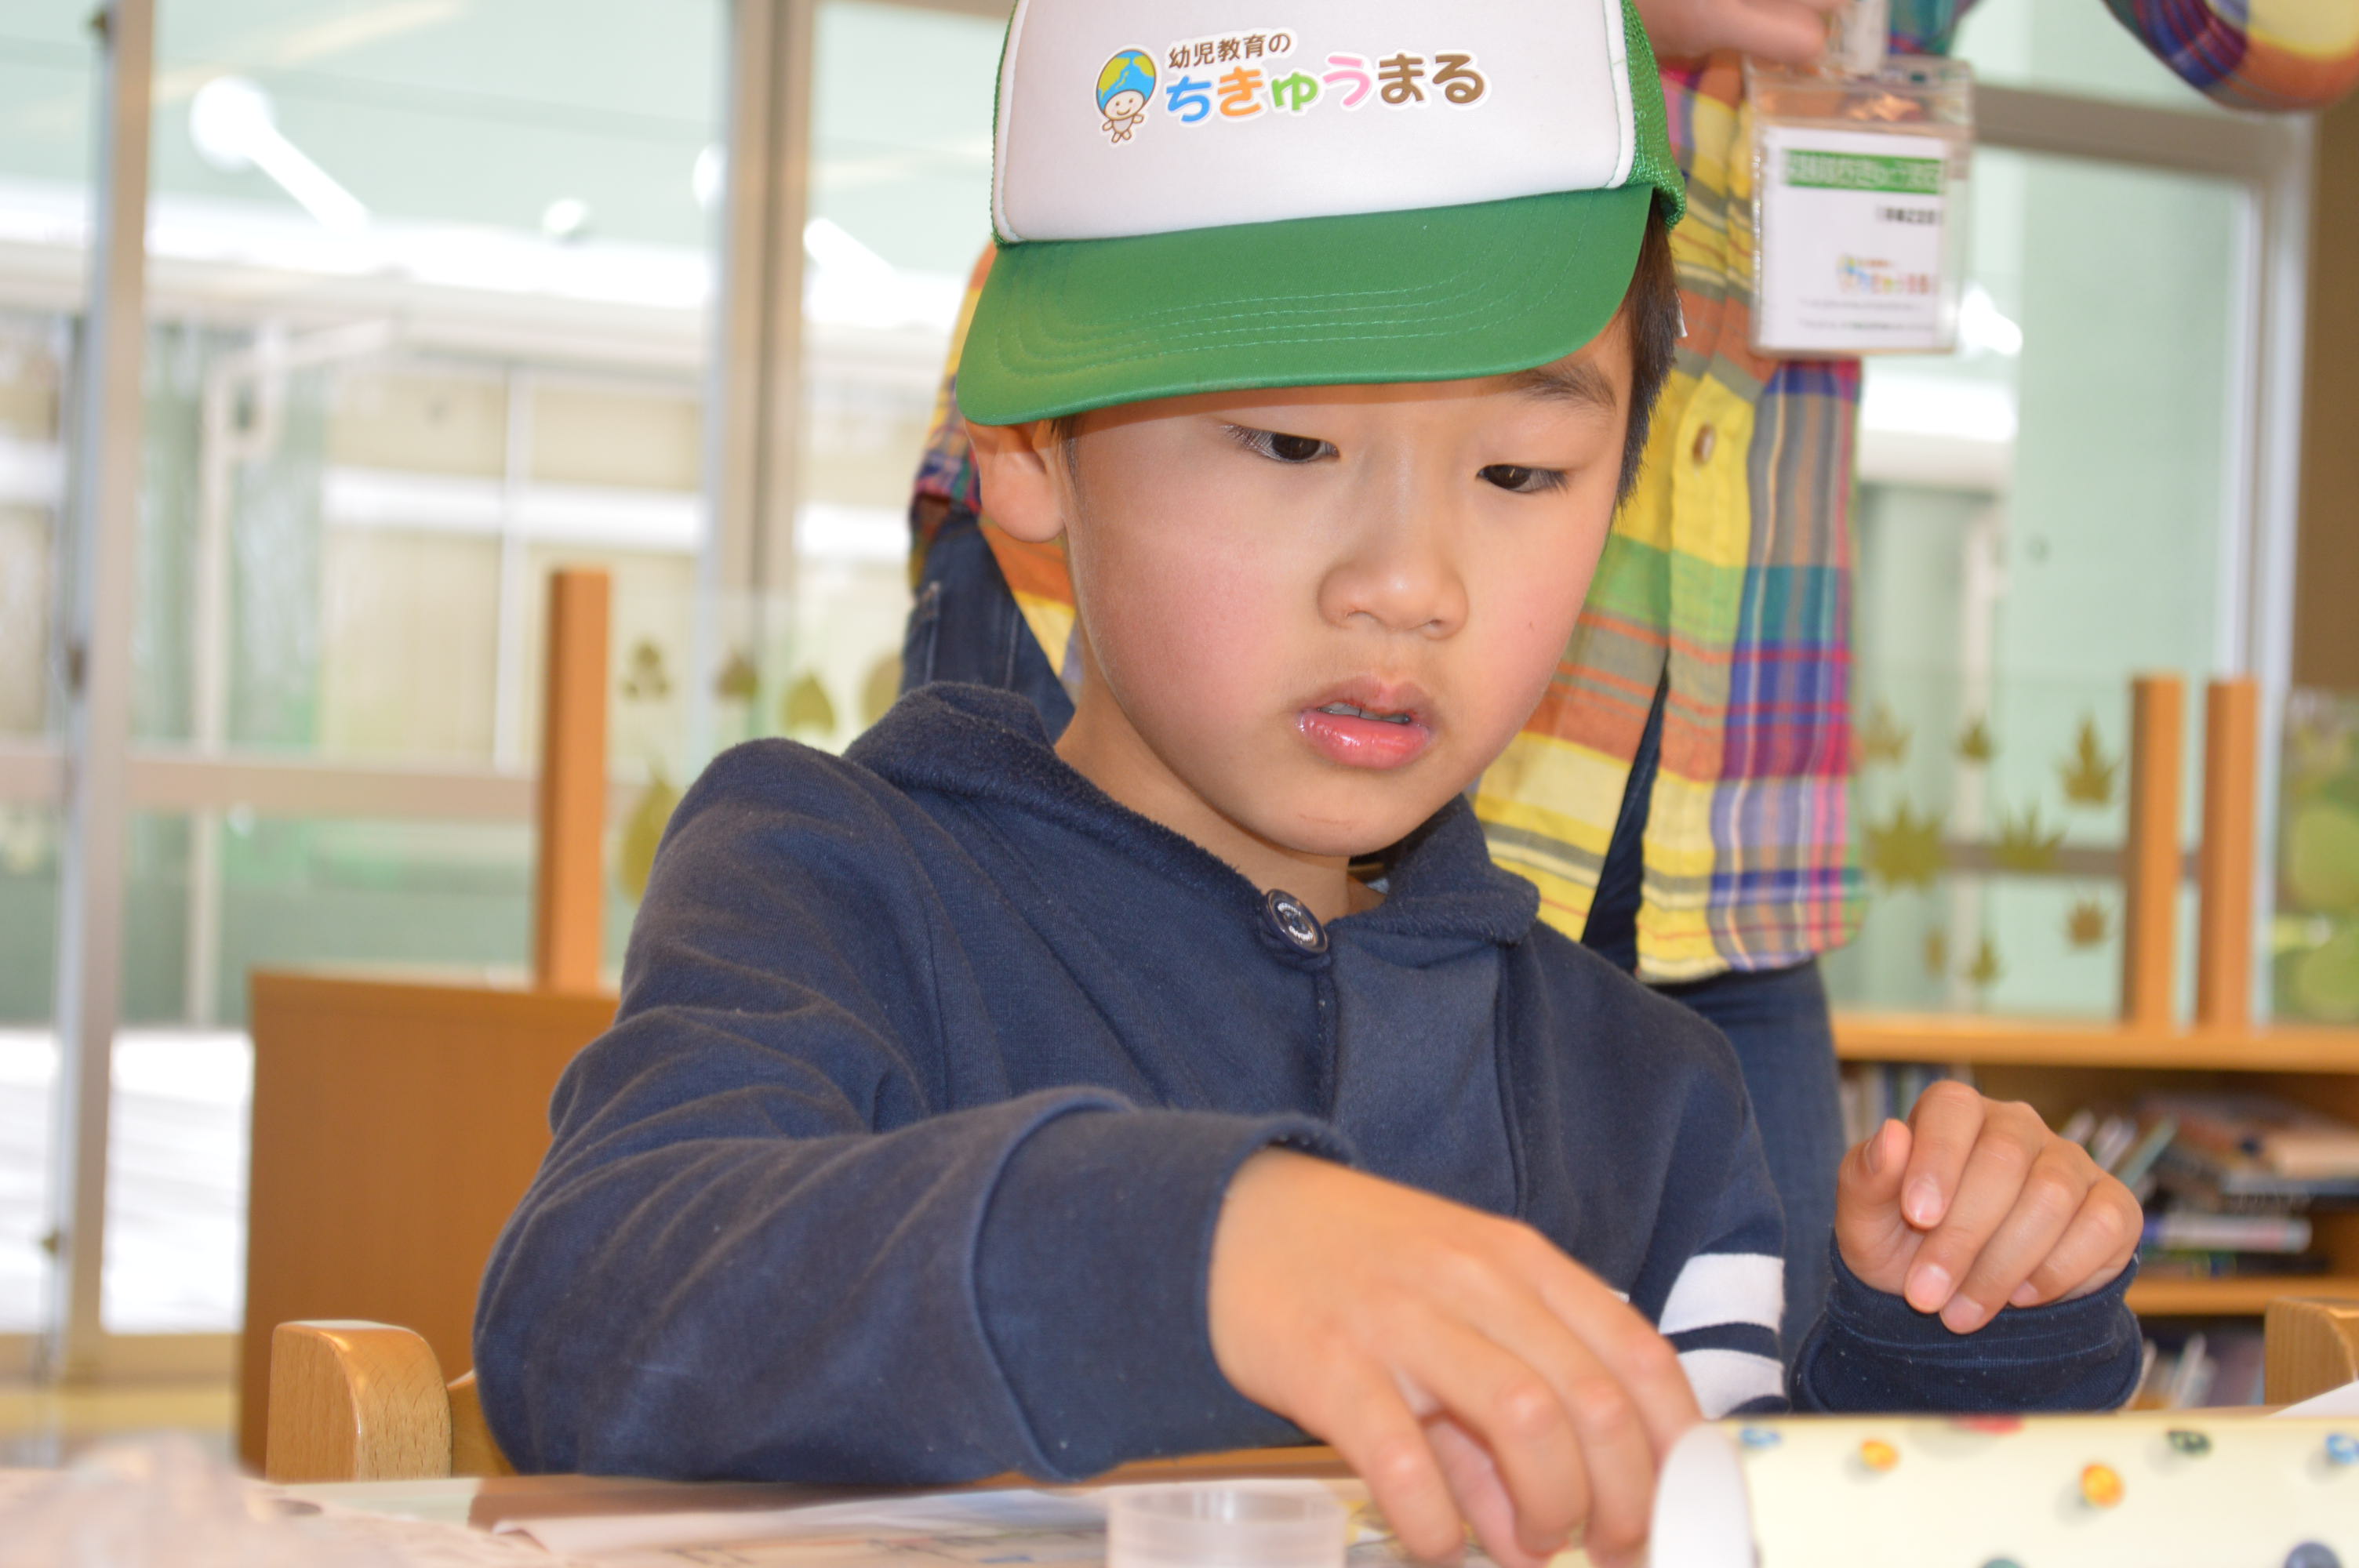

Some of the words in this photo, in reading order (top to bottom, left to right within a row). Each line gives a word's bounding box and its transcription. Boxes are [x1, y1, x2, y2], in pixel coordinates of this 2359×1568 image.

[1169, 32, 1291, 69] 幼児教育の
[1166, 53, 1485, 122] ちきゅうまる
